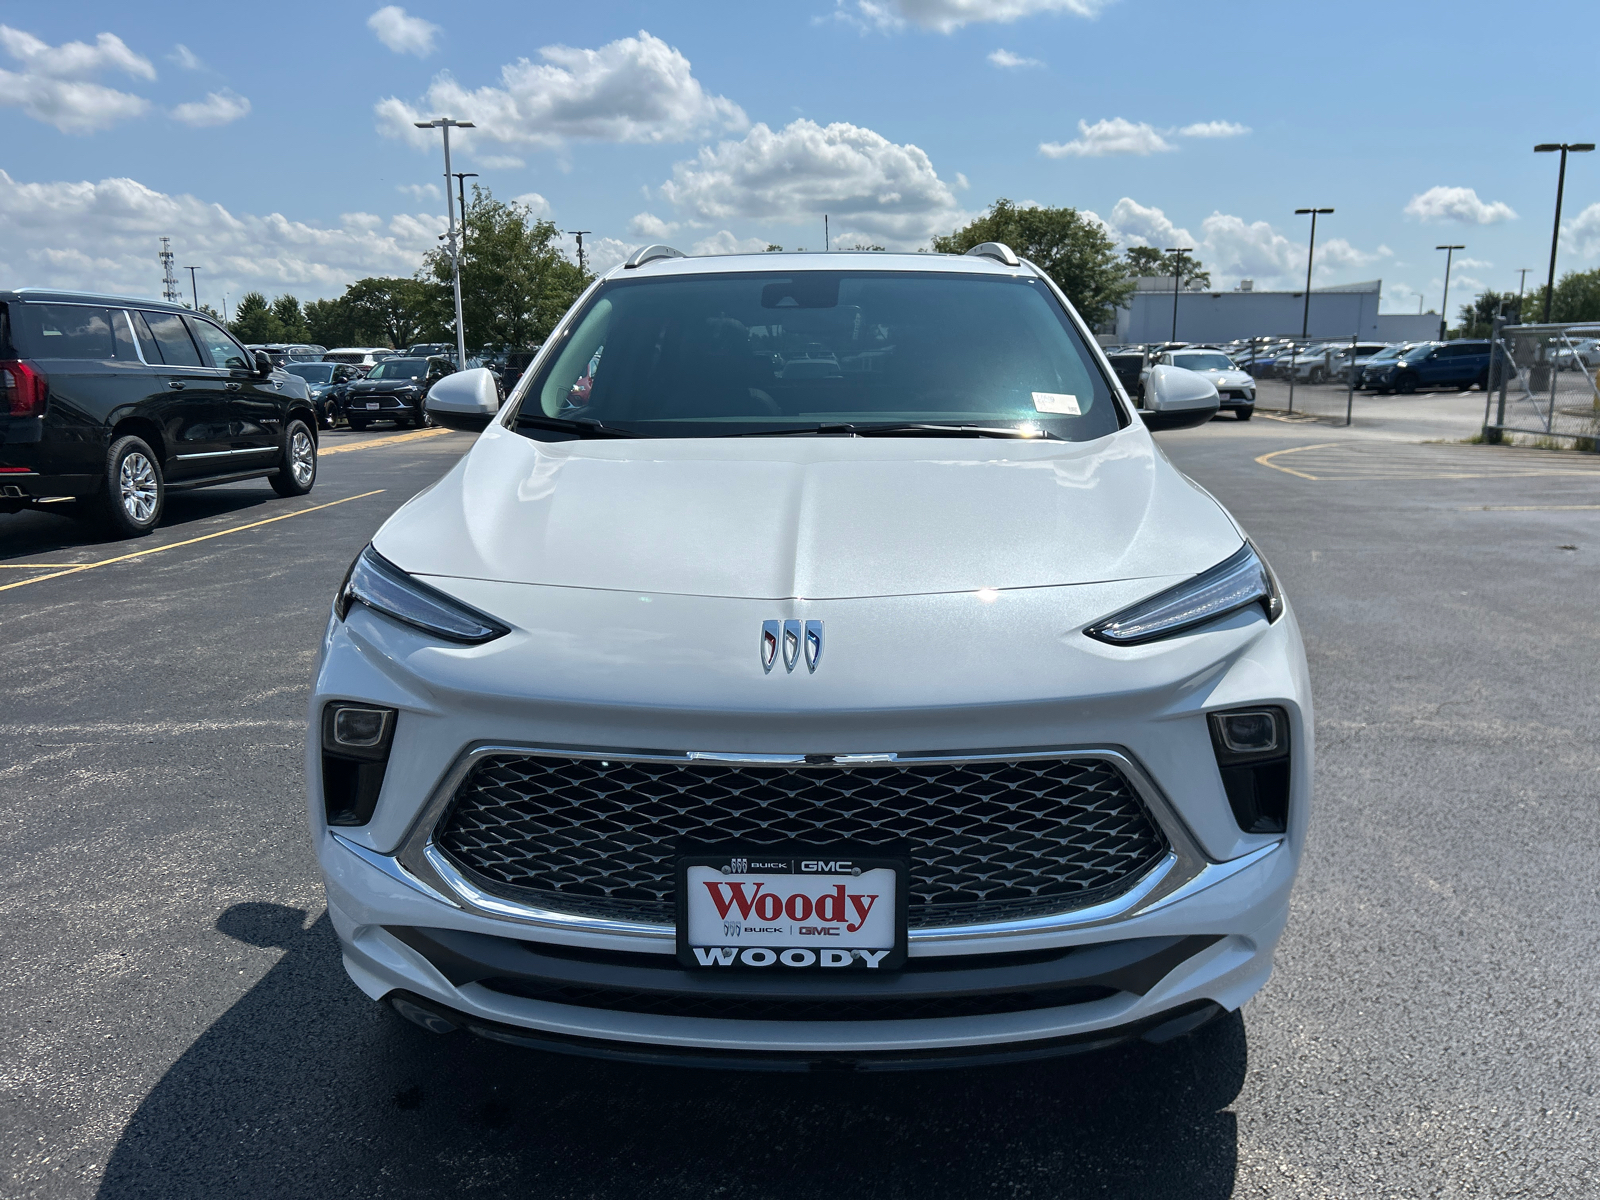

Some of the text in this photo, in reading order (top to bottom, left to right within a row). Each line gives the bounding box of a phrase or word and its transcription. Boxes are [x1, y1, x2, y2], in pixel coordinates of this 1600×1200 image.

[801, 861, 852, 872] GMC
[703, 881, 879, 933] Woody
[799, 926, 840, 936] GMC
[693, 948, 890, 968] WOODY
